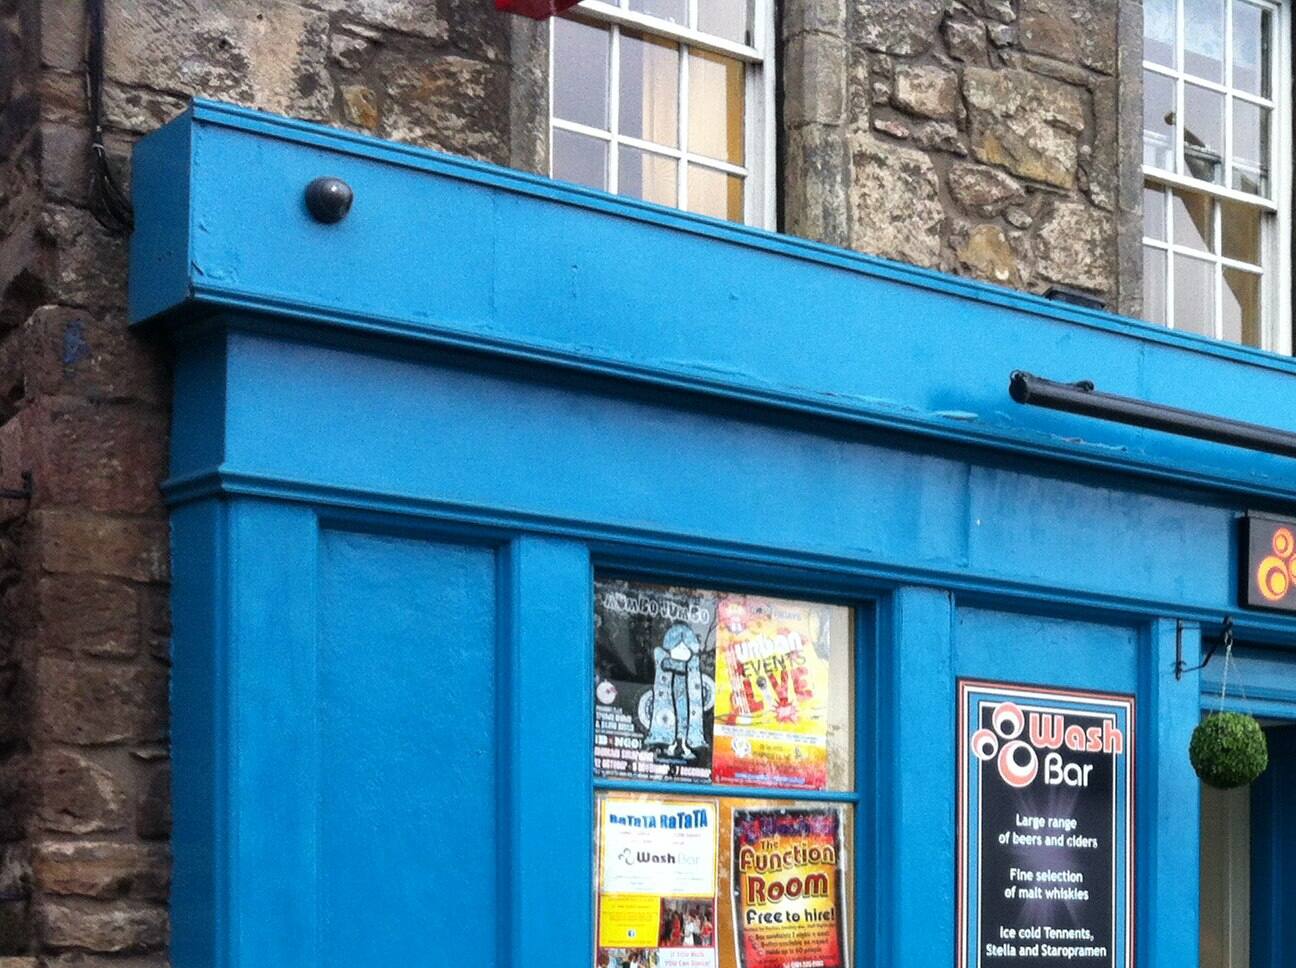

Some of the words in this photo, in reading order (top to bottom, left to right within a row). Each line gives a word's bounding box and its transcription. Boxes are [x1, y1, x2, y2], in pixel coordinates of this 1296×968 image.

[1029, 712, 1123, 754] Wash
[1044, 752, 1093, 787] Bar
[1016, 813, 1045, 830] Large
[1047, 816, 1077, 831] range
[998, 831, 1010, 844] of
[1012, 832, 1042, 846] beers
[1045, 834, 1064, 846] and
[1066, 835, 1098, 848] ciders
[637, 851, 676, 864] Wash
[739, 843, 836, 874] Function
[1009, 868, 1034, 881] Fine
[1036, 869, 1083, 883] selection
[1004, 886, 1016, 898] of
[1018, 886, 1042, 899] malt
[1044, 887, 1089, 901] whiskies
[746, 909, 783, 925] Free
[785, 911, 800, 923] to
[804, 908, 835, 922] hire!
[1000, 926, 1016, 939] Ice
[1018, 926, 1041, 939] cold
[1043, 927, 1094, 941] Tennents,
[986, 943, 1016, 957] Stella
[1019, 944, 1039, 957] and
[1041, 944, 1107, 959] Staropramen
